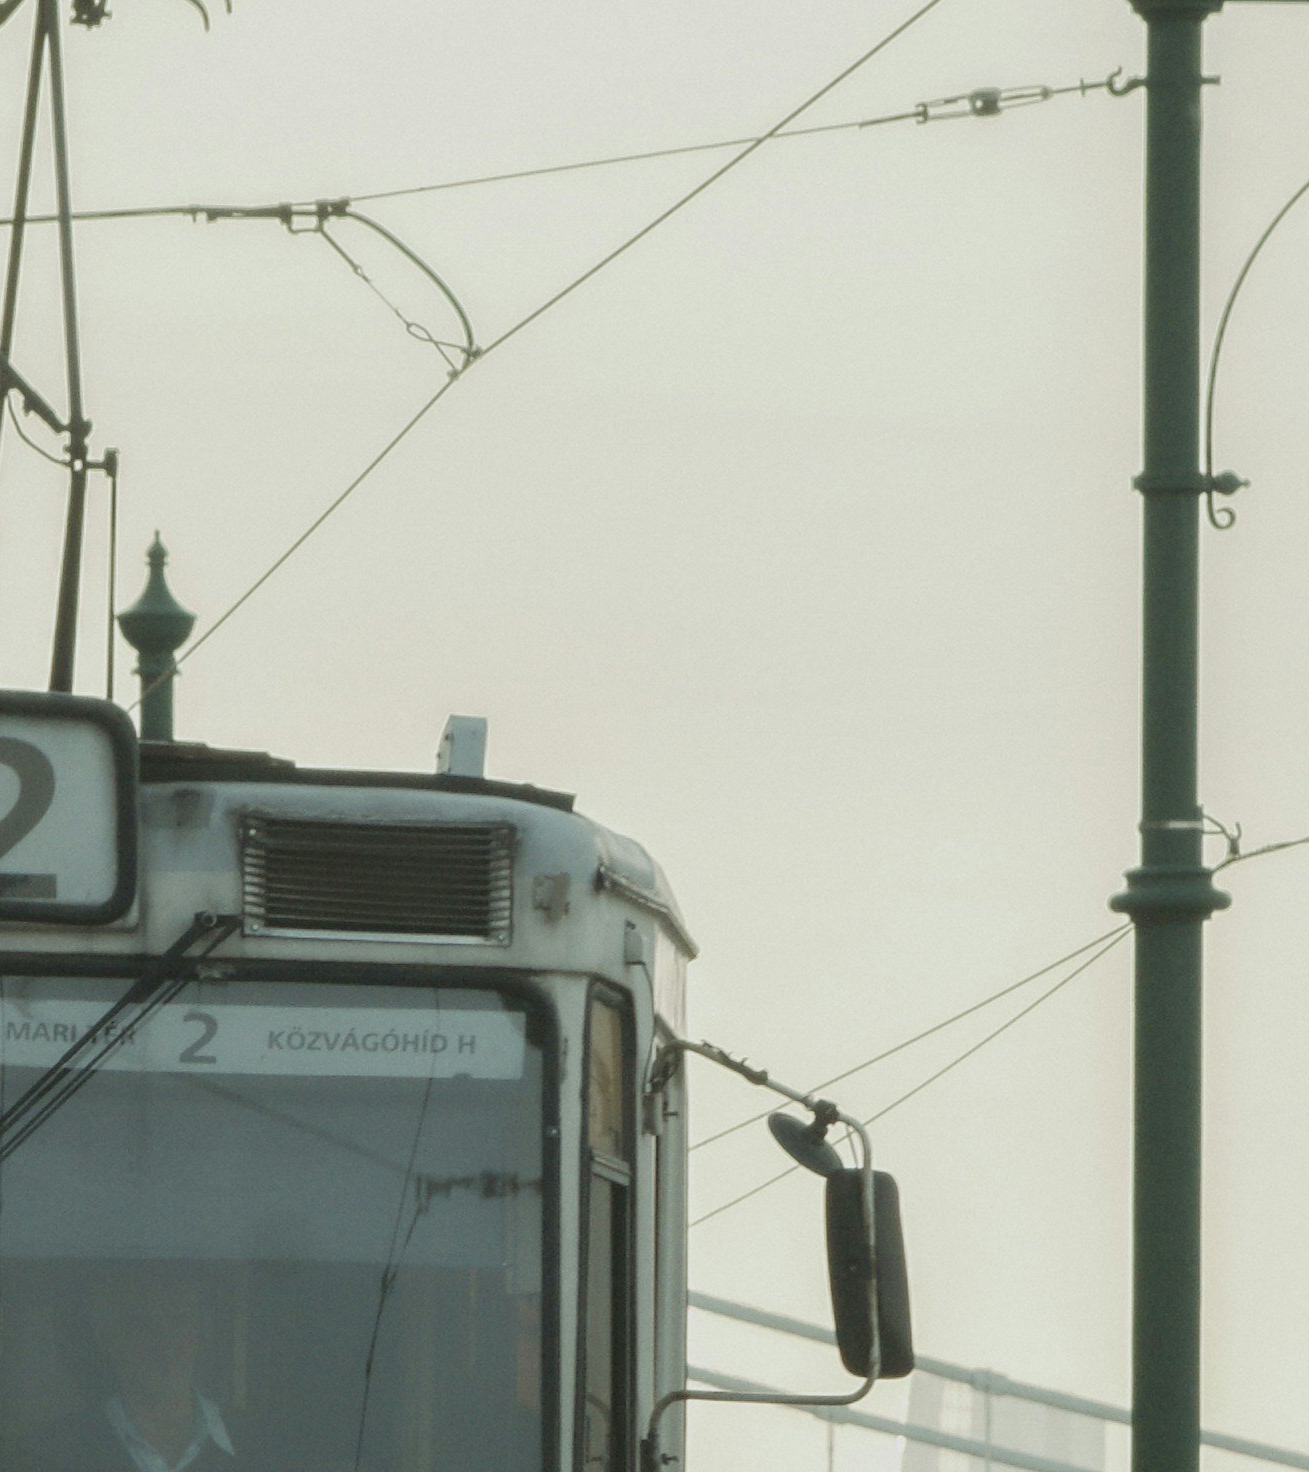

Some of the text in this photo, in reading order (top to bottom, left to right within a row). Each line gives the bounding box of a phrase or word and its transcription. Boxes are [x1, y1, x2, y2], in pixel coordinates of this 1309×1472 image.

[6, 1020, 77, 1043] MARI
[178, 1011, 220, 1065] 2
[266, 1026, 477, 1055] KÖZVÁGÓHÍD H
